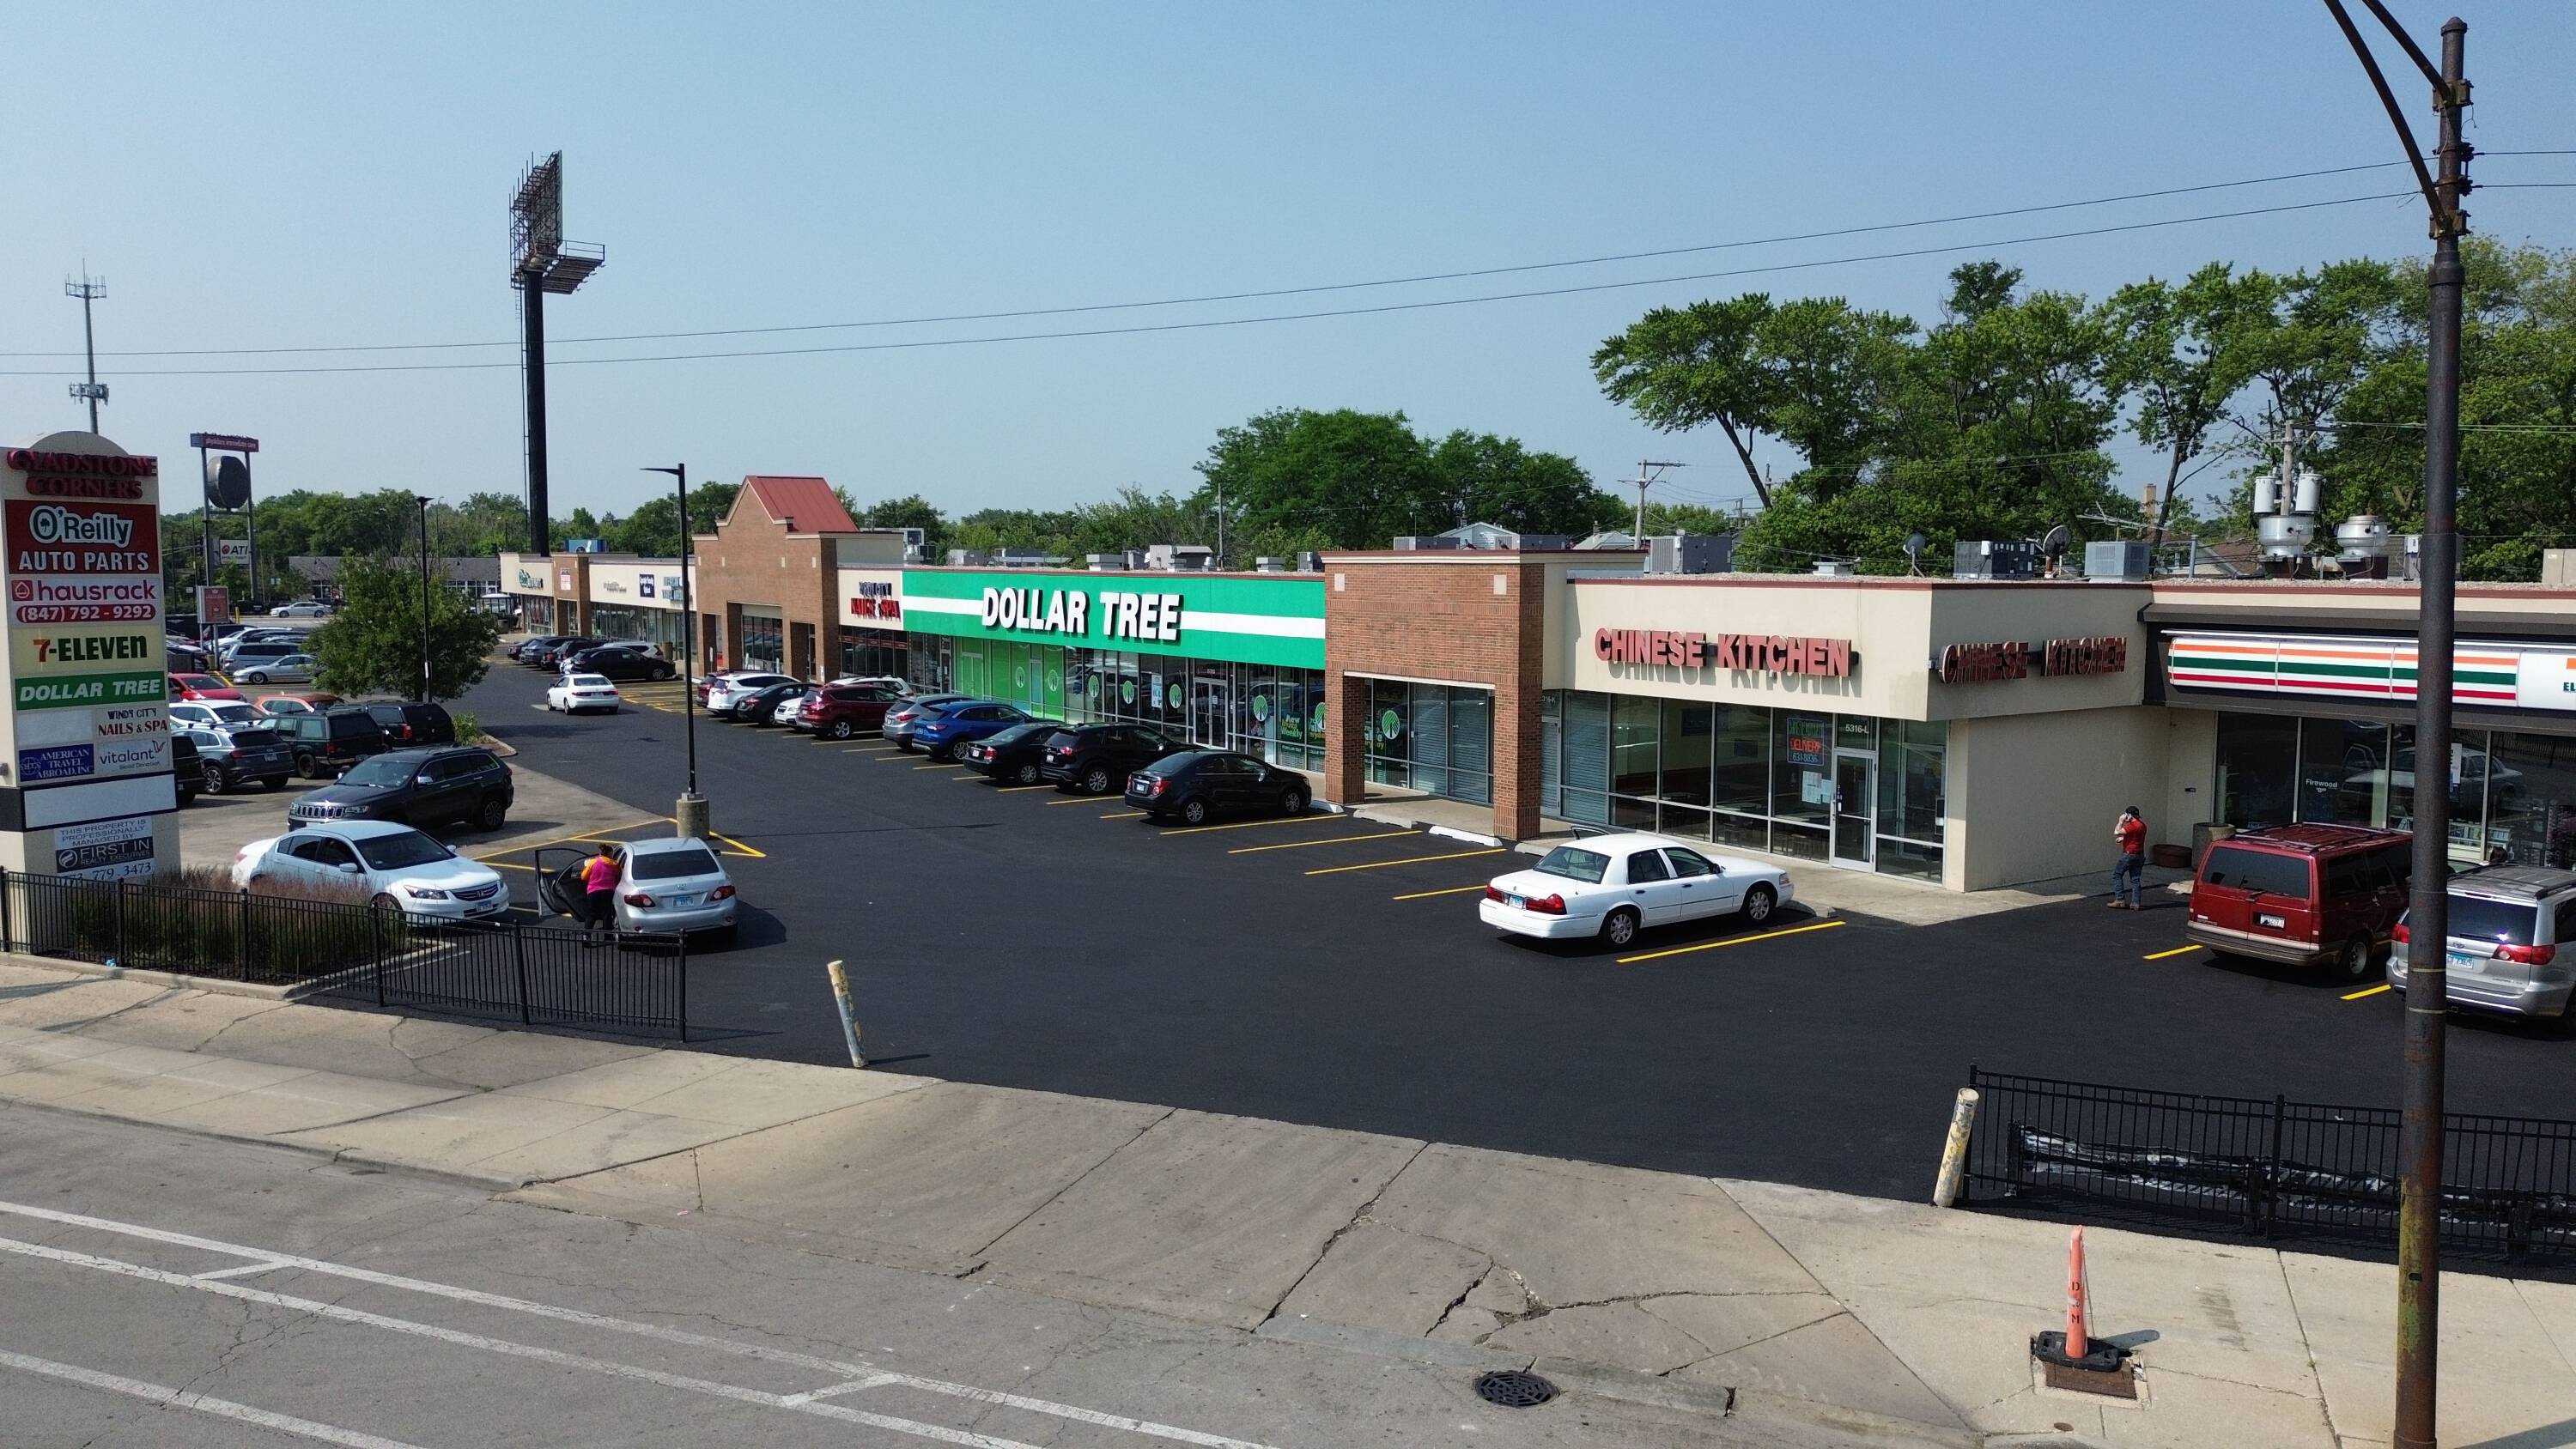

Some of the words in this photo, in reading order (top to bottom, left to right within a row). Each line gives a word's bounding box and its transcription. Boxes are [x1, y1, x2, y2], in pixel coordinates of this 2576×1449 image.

[27, 476, 143, 499] CORNERS
[32, 506, 132, 546] O'Reilly
[231, 545, 248, 555] ATI
[19, 551, 76, 571] AUTO
[84, 552, 149, 571] PARTS
[38, 579, 155, 601] hausrack
[21, 605, 65, 622] (847)
[70, 605, 100, 619] 792
[112, 605, 152, 618] 9292
[982, 587, 1089, 634] DOLLAR
[1100, 591, 1183, 640] TREE
[1595, 627, 1707, 667] CHINESE
[1717, 633, 1852, 677] KITCHEN
[1939, 640, 2029, 685] CHINESE
[2043, 637, 2128, 676] KITCHEN
[20, 682, 104, 701] DOLLAR
[112, 678, 161, 695] TREE
[107, 709, 134, 720] WINDY
[136, 708, 157, 718] CITY
[98, 722, 133, 736] NAILS
[136, 724, 143, 733] &
[145, 719, 168, 732] SPA
[40, 749, 89, 761] AMERICAN
[49, 758, 82, 768] TRAVEL
[100, 748, 155, 765] vitalant
[2306, 779, 2338, 788] Firewood
[61, 828, 82, 836] THIS
[84, 821, 135, 833] PROPERTY
[62, 825, 145, 842] PROFESSIONALLY
[72, 835, 119, 846] MANAGED
[80, 842, 129, 858] FIRST
[133, 839, 149, 852] IN
[82, 857, 106, 865] REALTY
[123, 862, 152, 876] 3473
